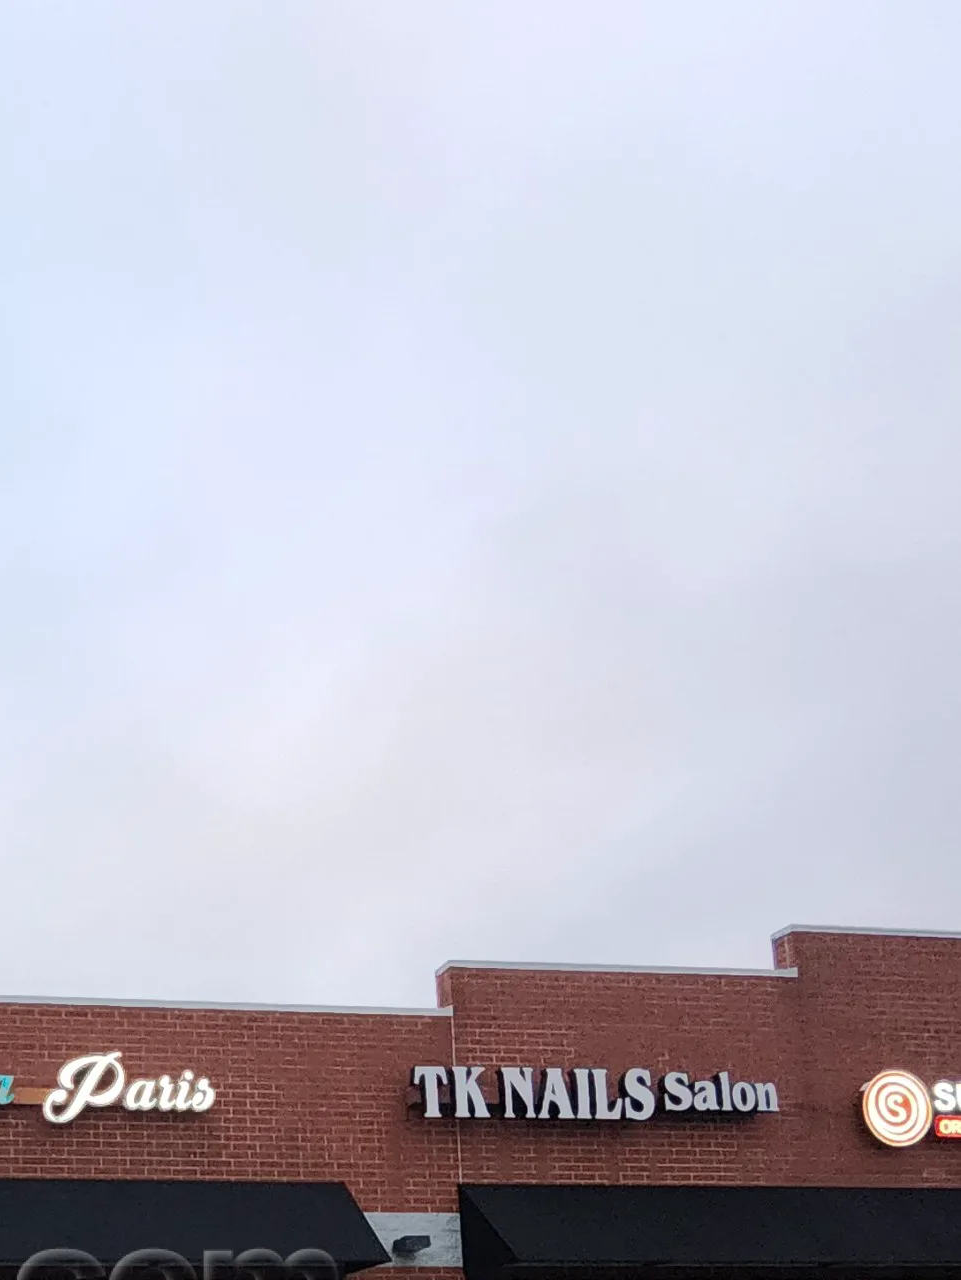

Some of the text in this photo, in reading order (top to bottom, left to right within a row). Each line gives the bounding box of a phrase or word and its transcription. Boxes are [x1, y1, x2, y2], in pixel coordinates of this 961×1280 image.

[41, 1050, 217, 1125] Paris
[413, 1064, 780, 1122] TK NAILS Salon
